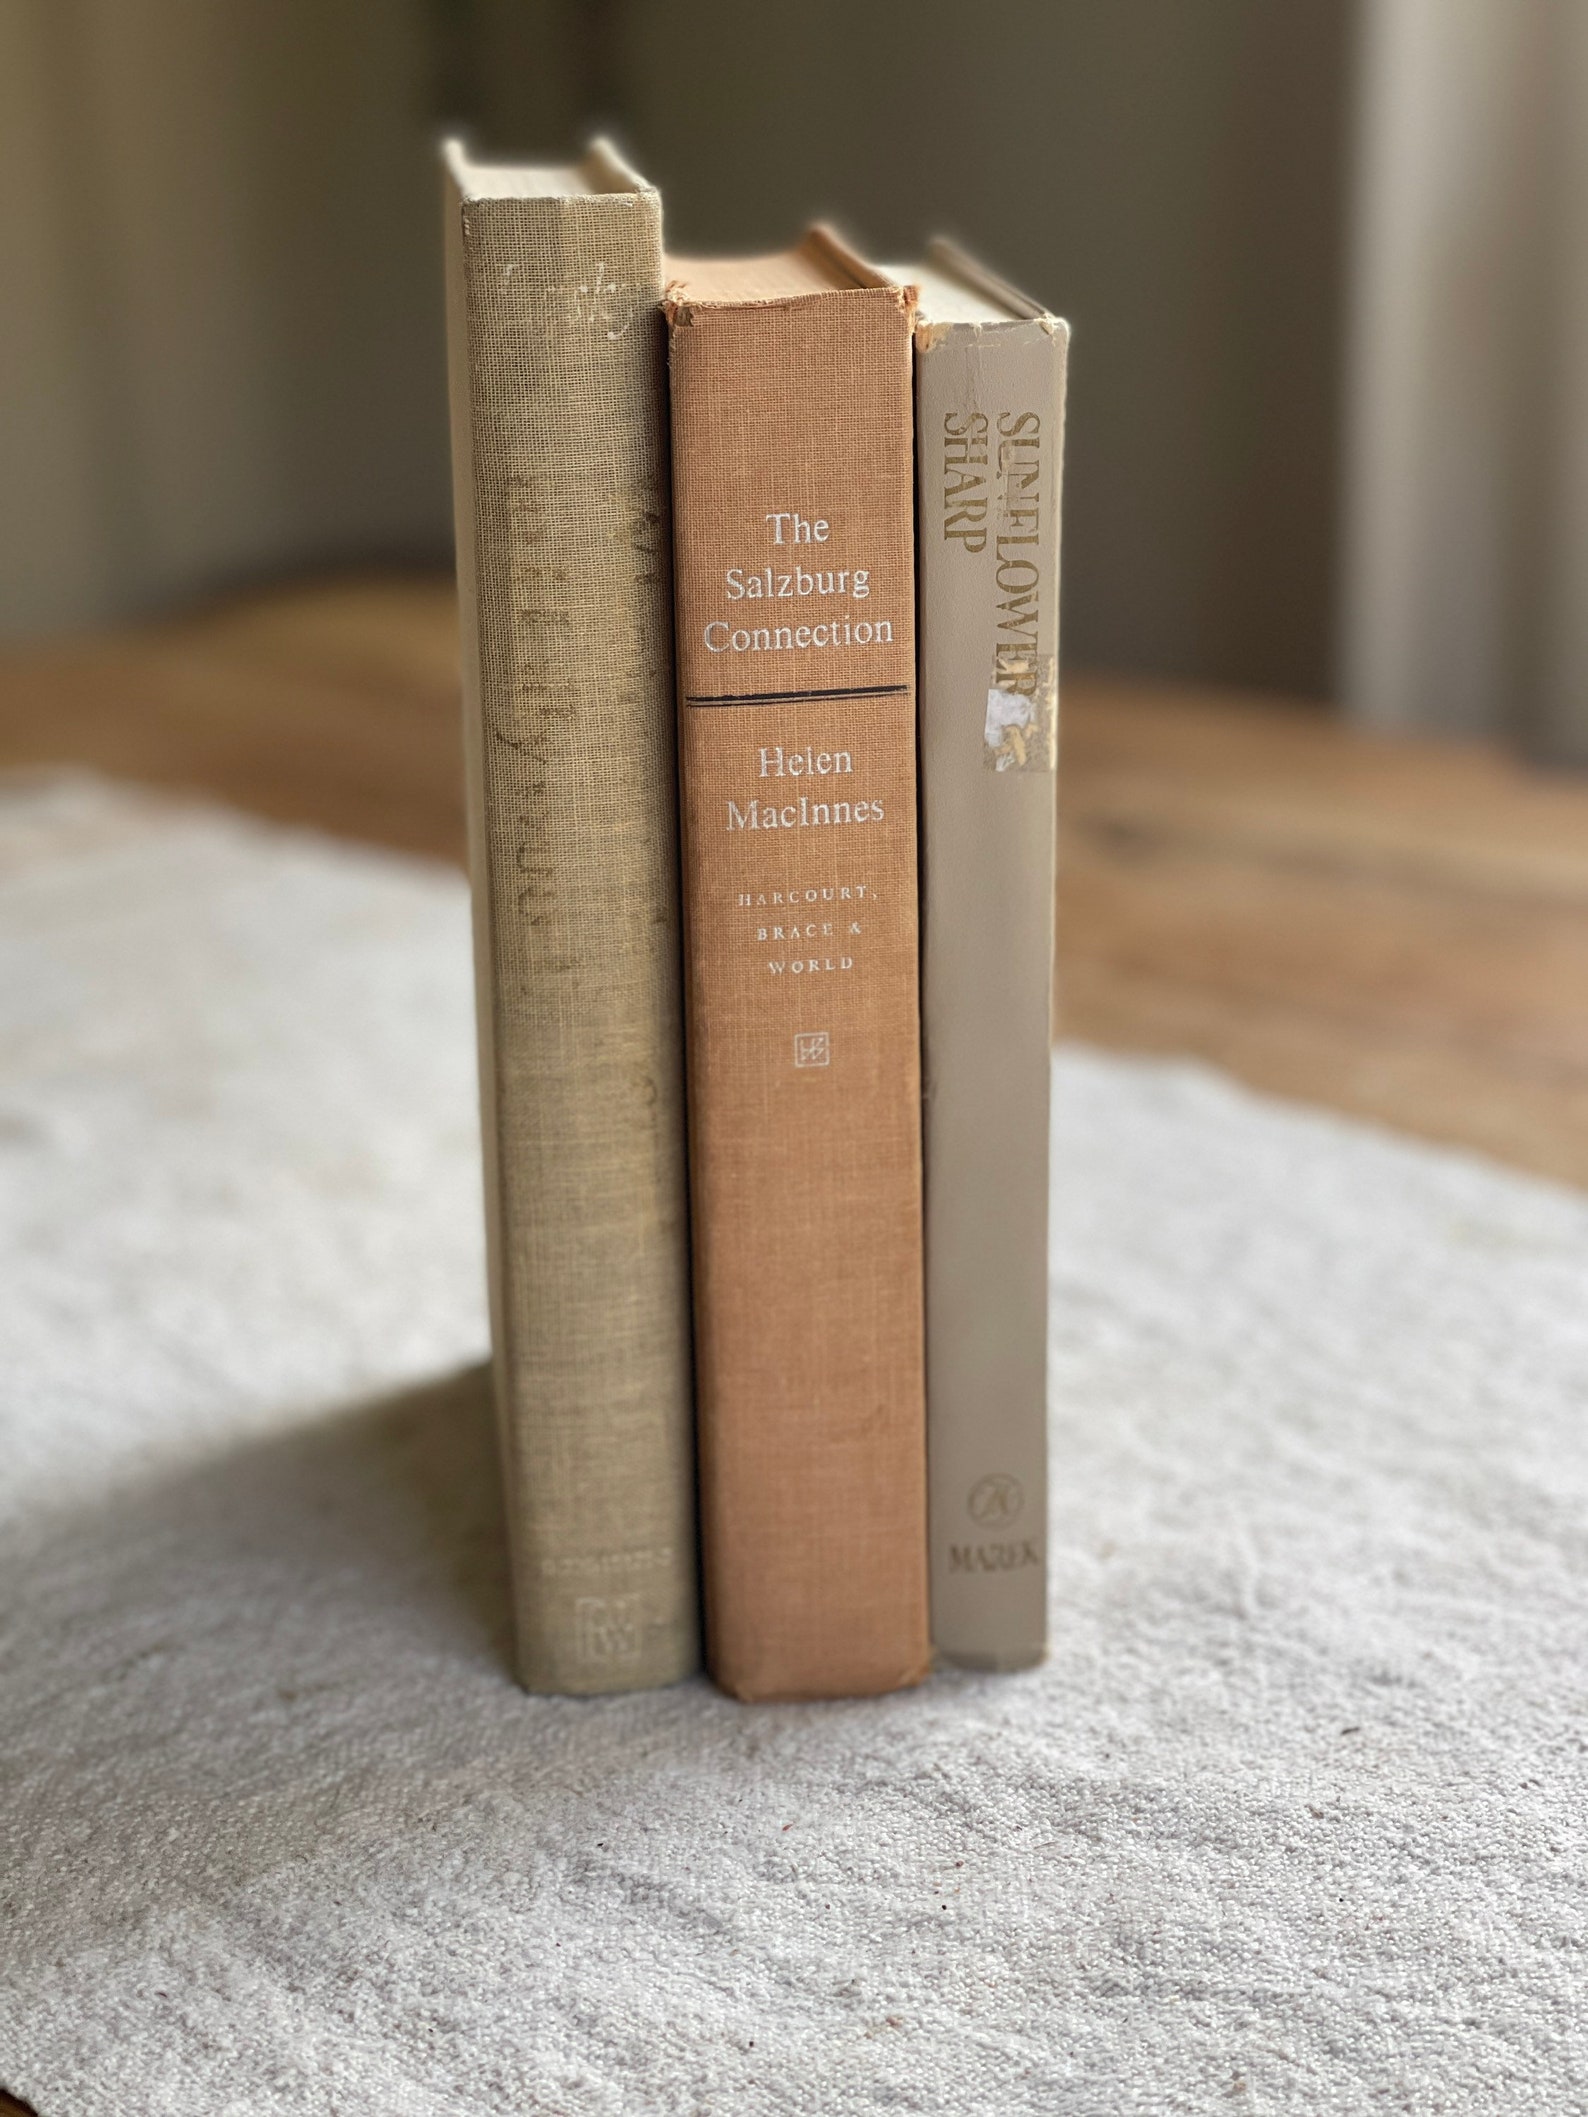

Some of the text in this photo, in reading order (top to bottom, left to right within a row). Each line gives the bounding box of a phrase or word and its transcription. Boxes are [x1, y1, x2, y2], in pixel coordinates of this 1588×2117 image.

[943, 411, 989, 554] SHARP
[766, 512, 829, 545] The
[726, 565, 870, 600] Salzburg
[704, 616, 893, 653] Connection
[759, 746, 853, 777] Helen
[726, 796, 885, 832] MacInnes
[738, 885, 879, 906] HARCOURT,
[757, 921, 862, 941] BRACE &
[768, 956, 853, 974] WORLD
